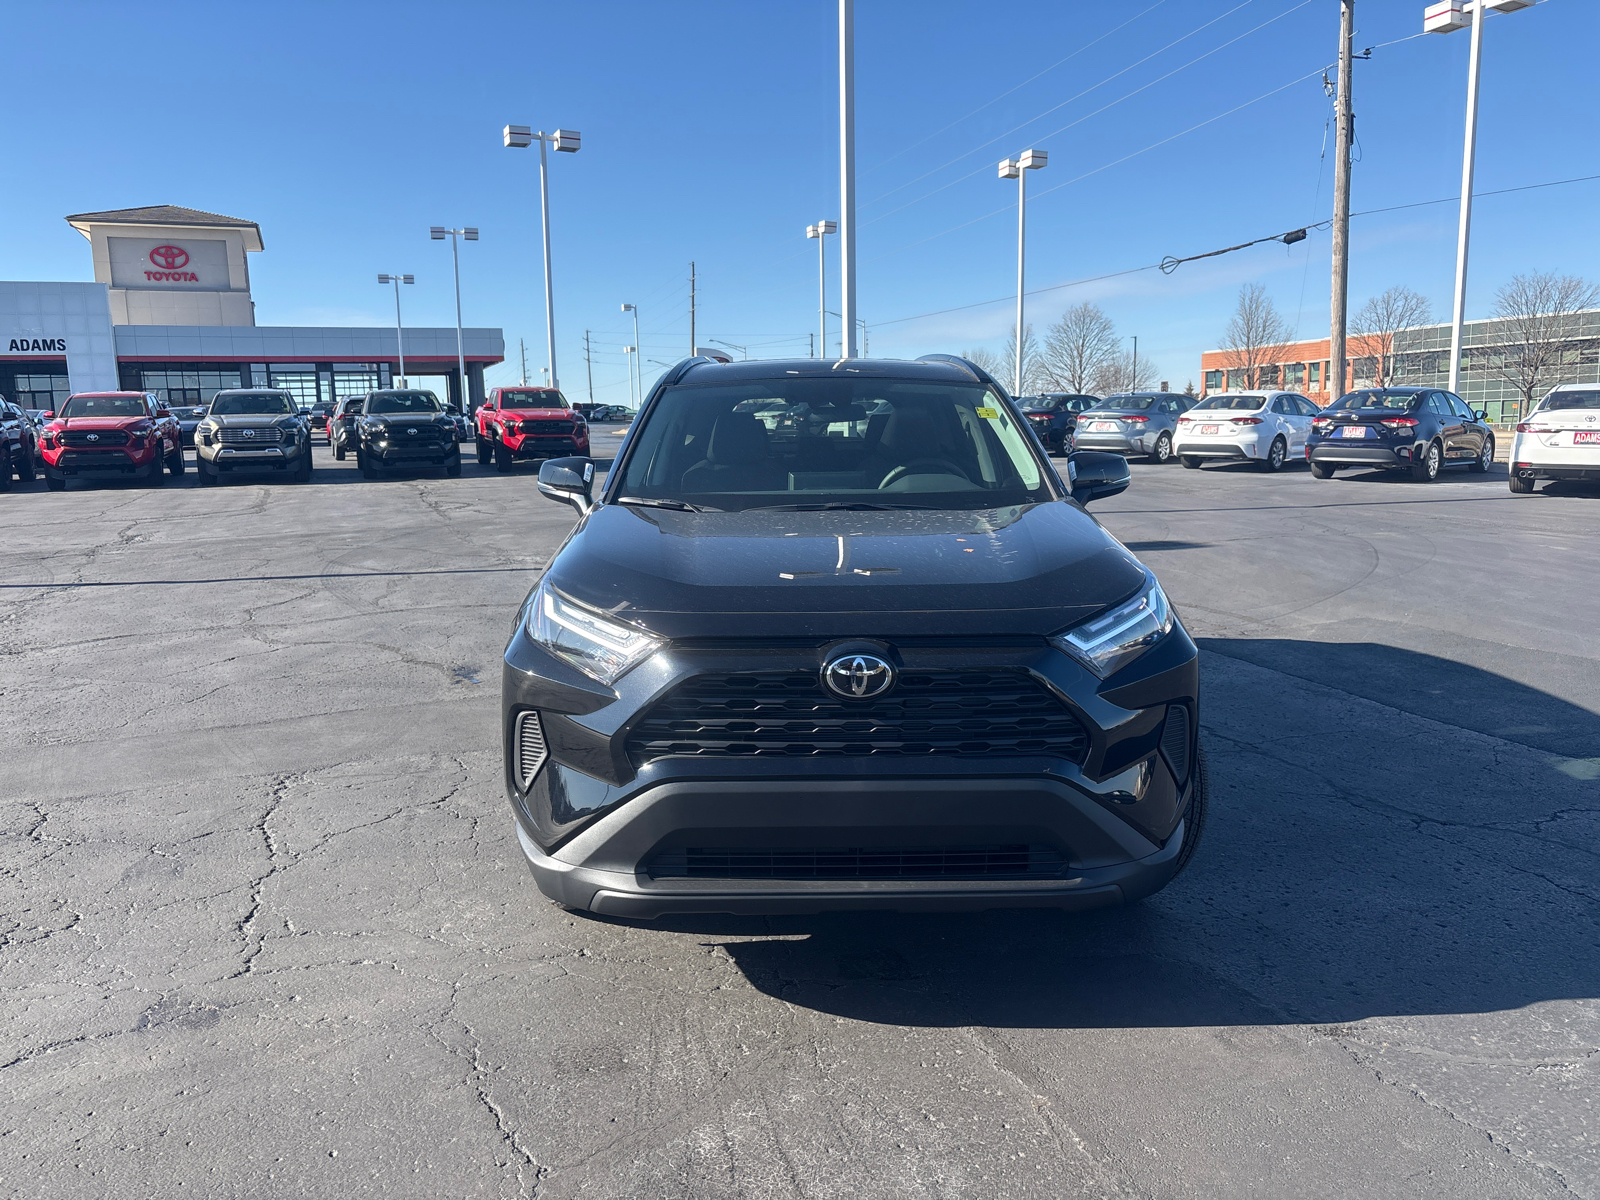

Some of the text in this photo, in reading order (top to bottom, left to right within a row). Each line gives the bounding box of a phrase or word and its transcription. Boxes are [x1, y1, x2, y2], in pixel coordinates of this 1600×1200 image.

[143, 271, 199, 282] TOYOTA
[9, 338, 67, 351] ADAMS
[1344, 427, 1365, 436] ADAMS
